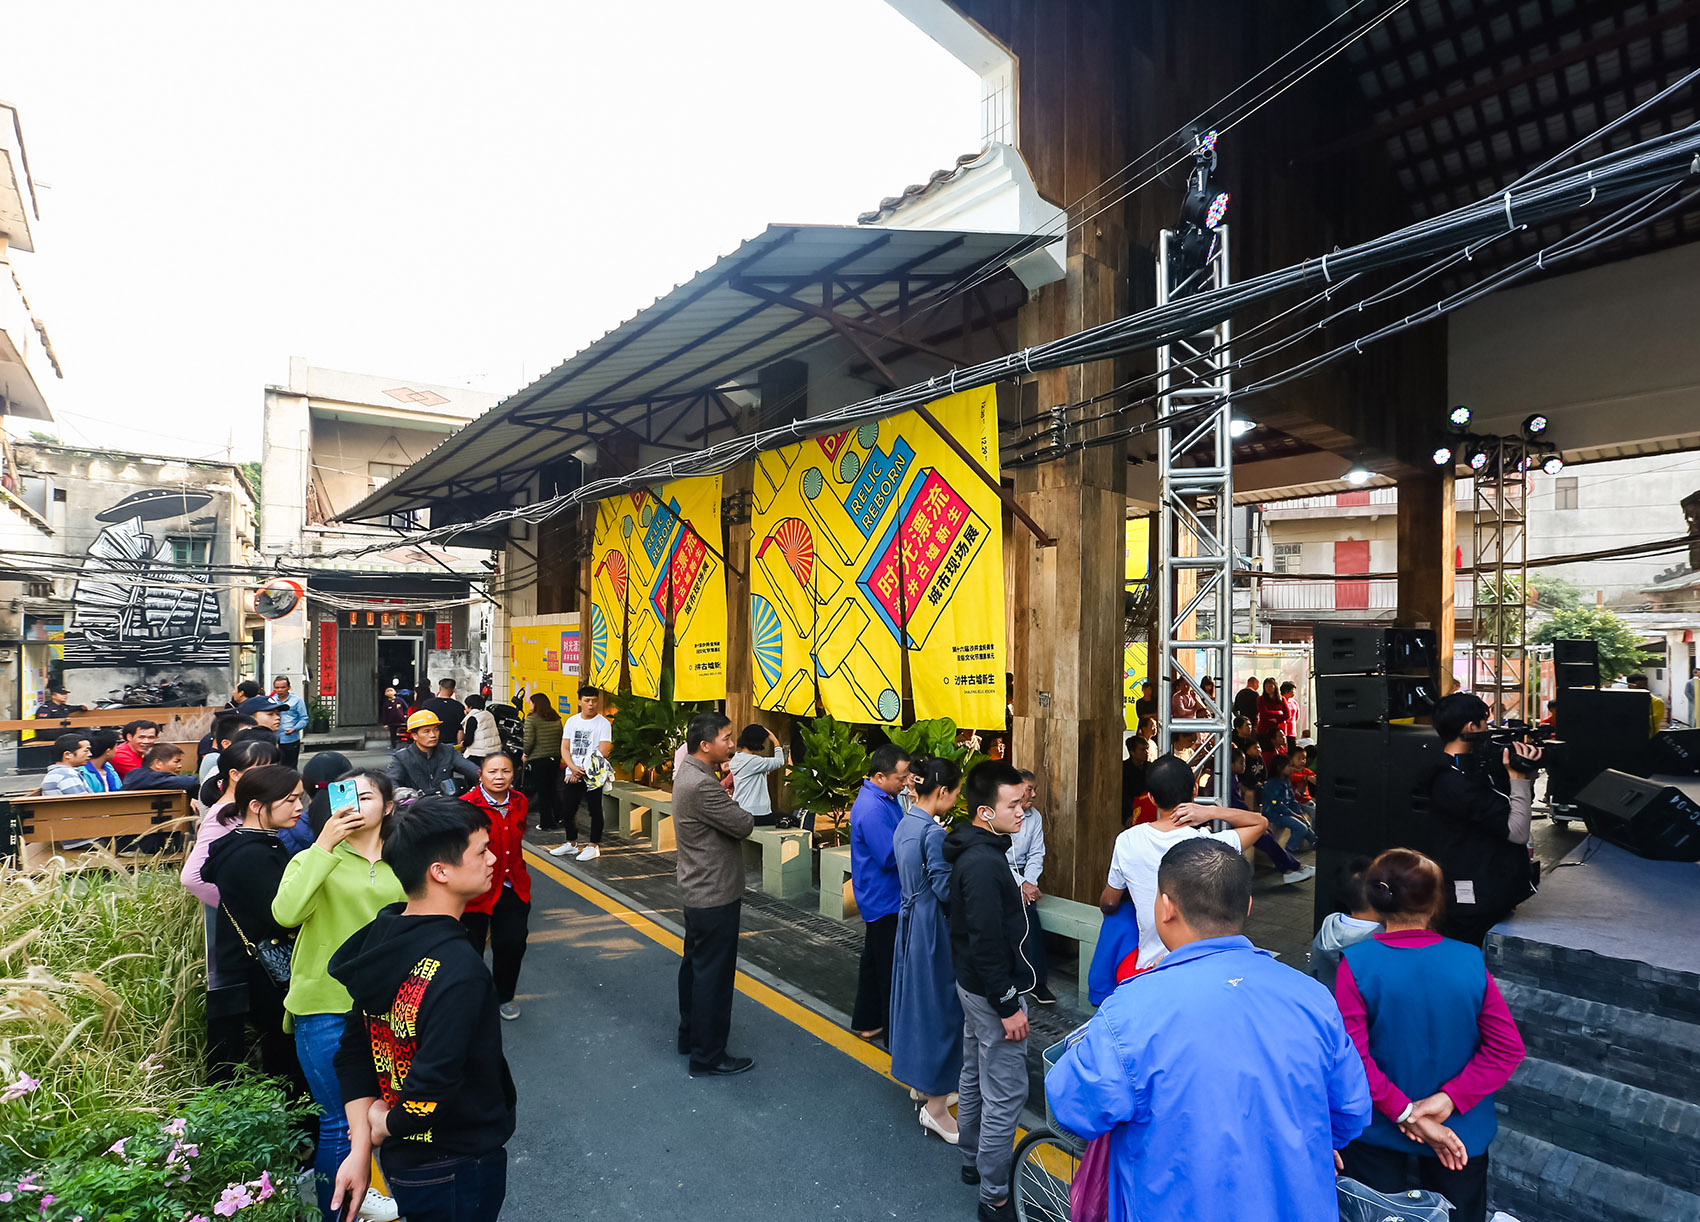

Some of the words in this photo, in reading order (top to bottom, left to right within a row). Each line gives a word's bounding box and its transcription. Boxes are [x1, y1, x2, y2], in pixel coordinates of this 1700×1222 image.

[850, 461, 883, 516] RELIC
[861, 453, 906, 531] REBORN
[646, 512, 664, 550] RELIC
[877, 483, 950, 599] 时光漂流
[927, 523, 980, 606] 城市现场展
[954, 673, 995, 686] 沙井古墟新生
